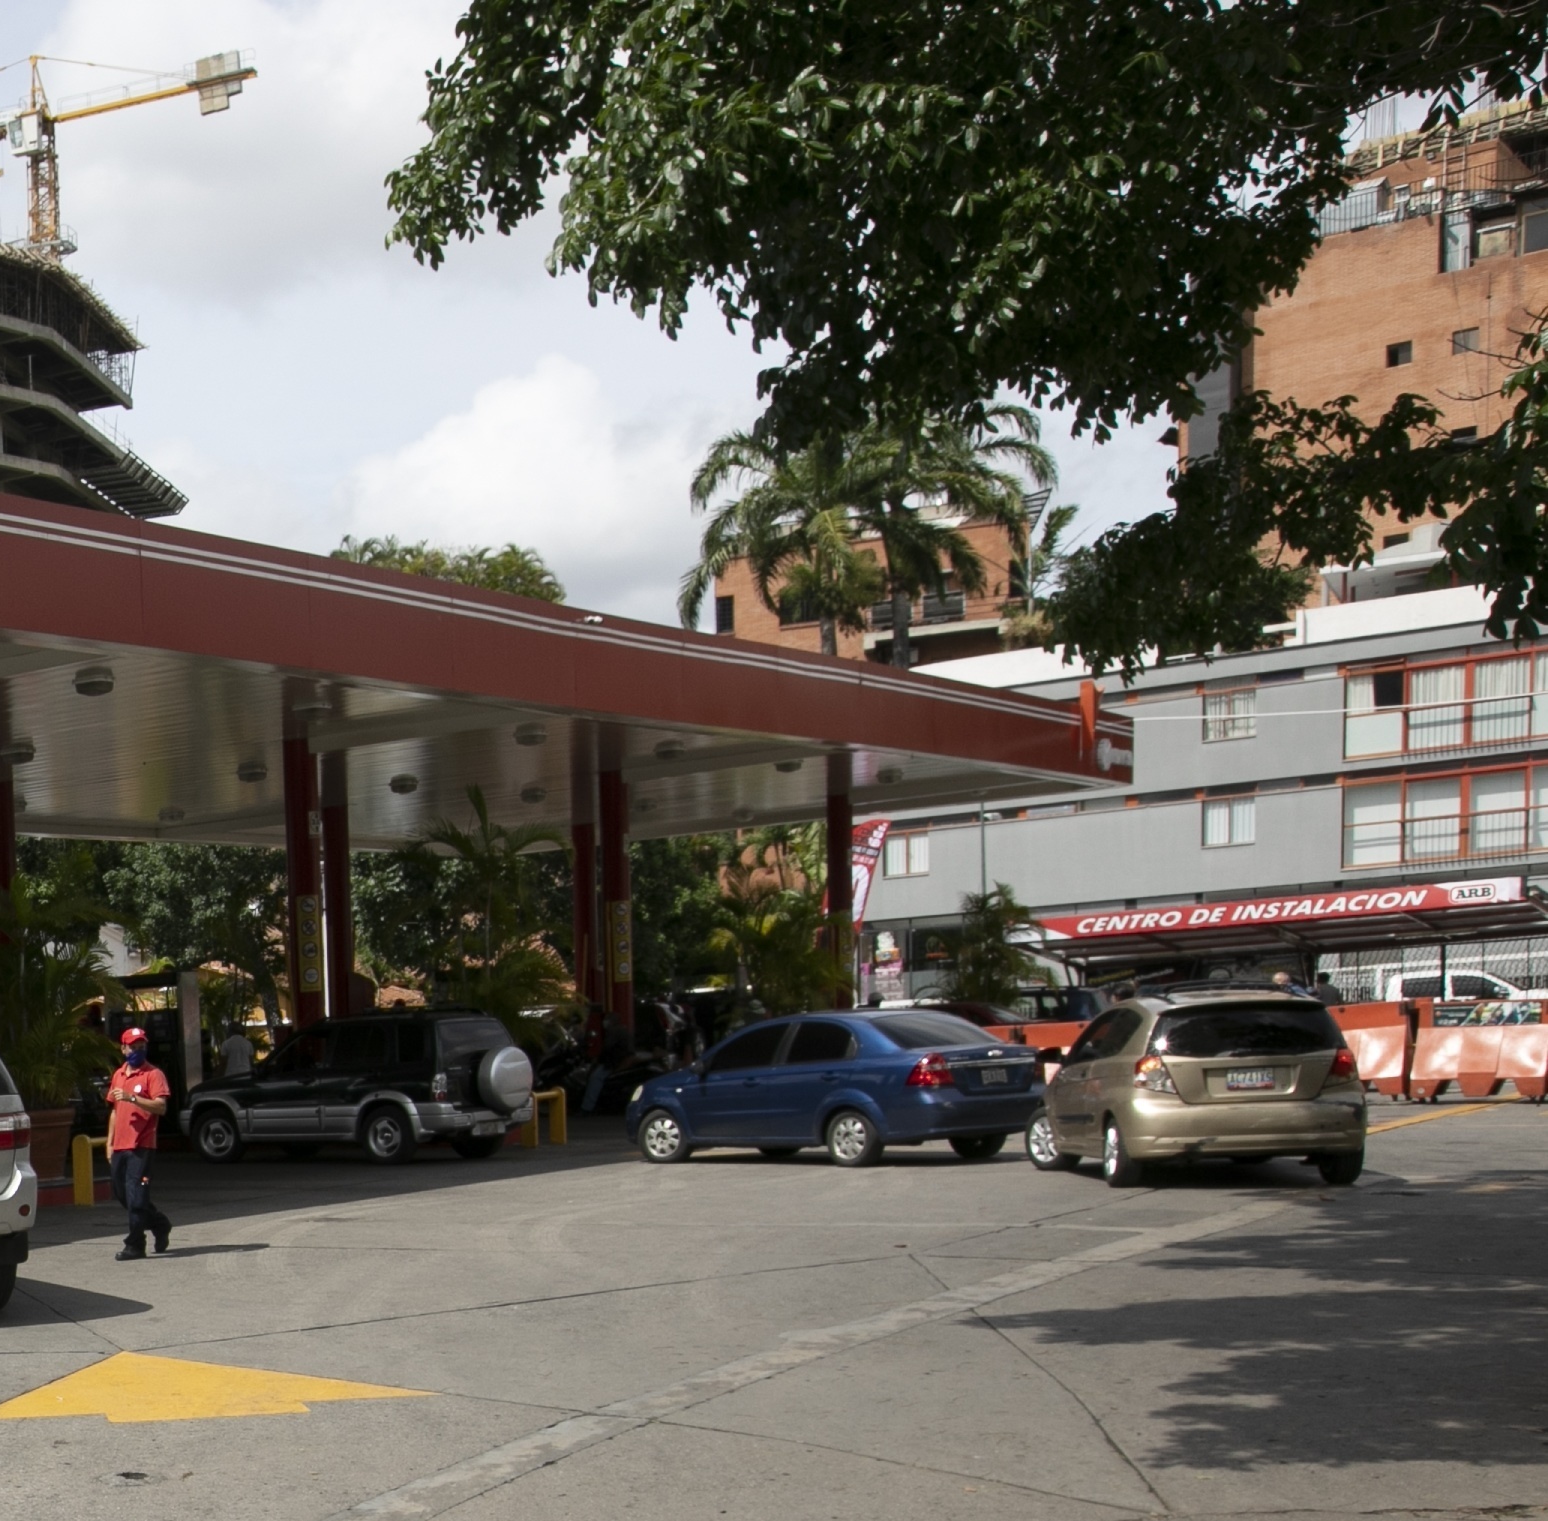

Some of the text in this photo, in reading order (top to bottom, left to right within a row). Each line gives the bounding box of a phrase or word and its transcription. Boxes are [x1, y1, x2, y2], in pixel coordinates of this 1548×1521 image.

[1455, 887, 1492, 900] ARB
[1076, 890, 1428, 934] CENTRO DE INSTALACION
